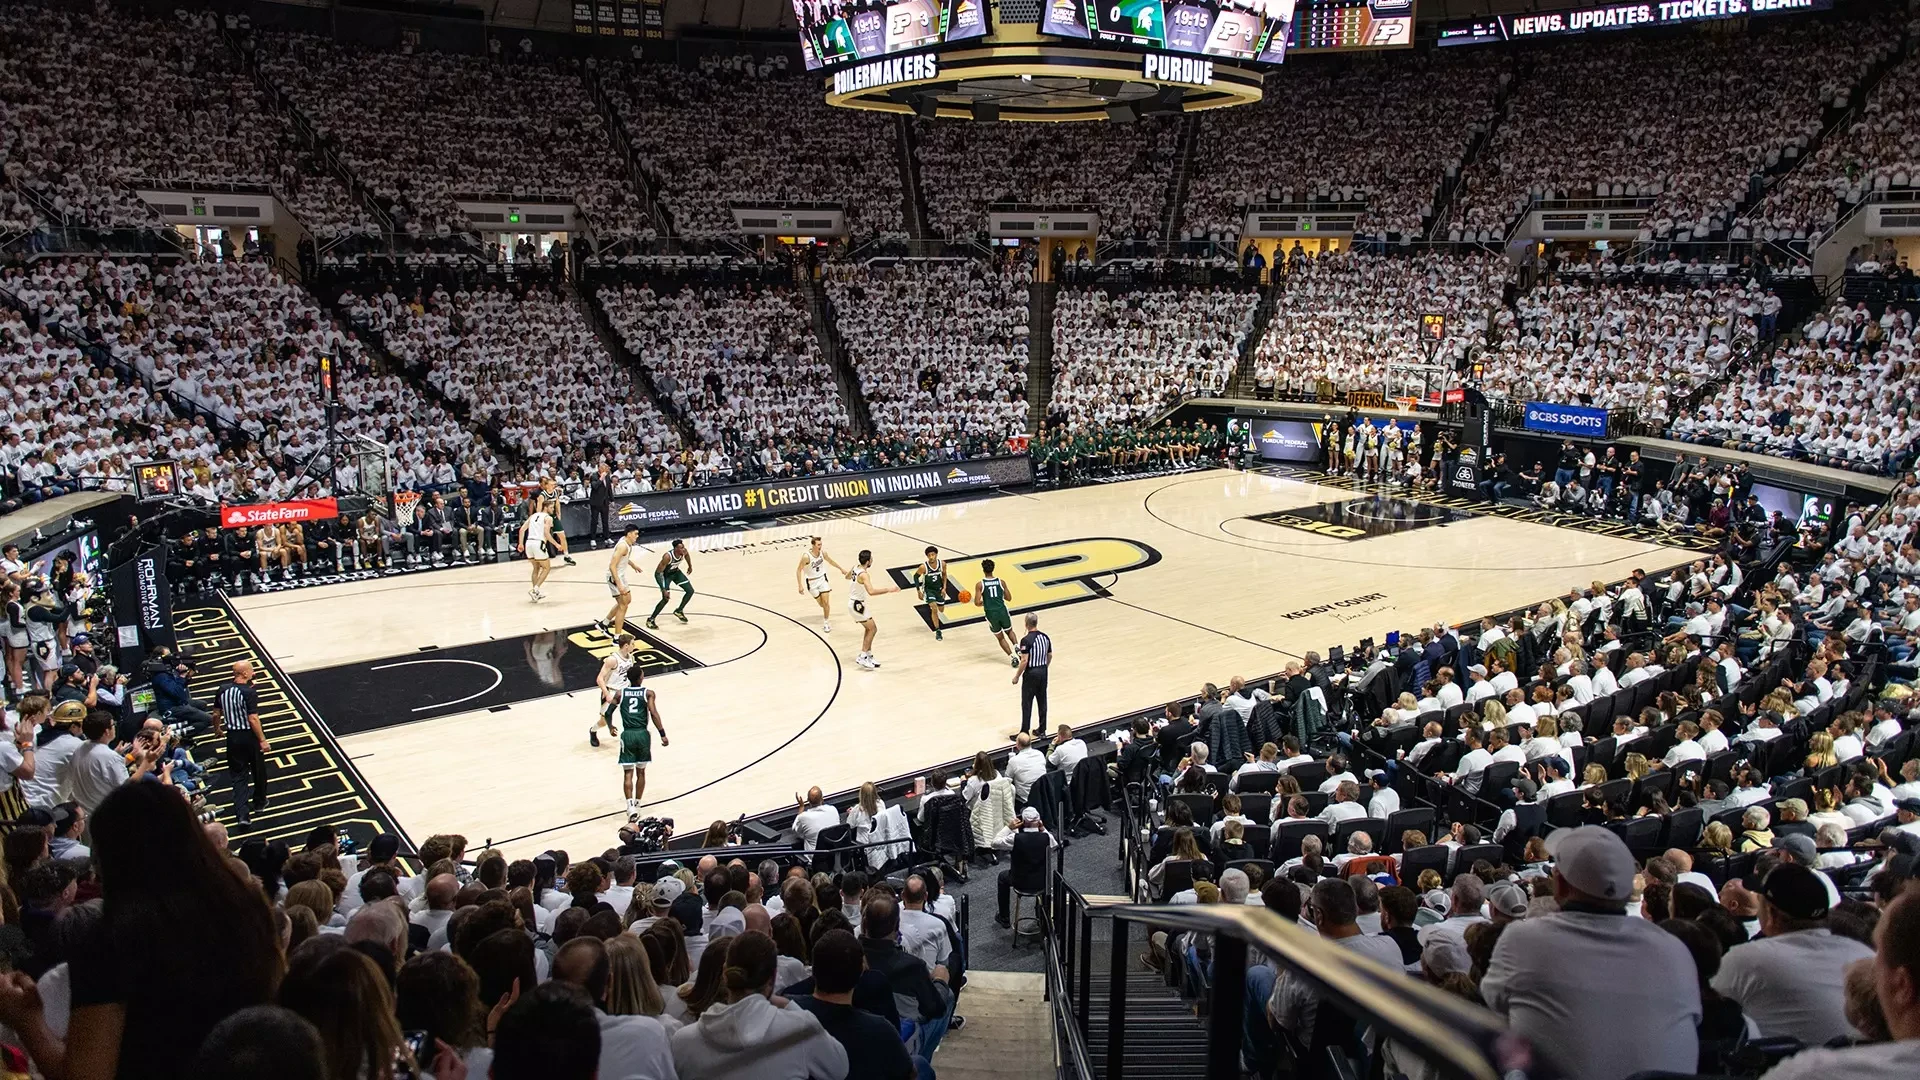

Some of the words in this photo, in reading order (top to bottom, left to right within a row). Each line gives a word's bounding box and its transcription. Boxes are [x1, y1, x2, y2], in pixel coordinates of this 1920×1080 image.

[920, 10, 929, 26] 3
[1110, 6, 1120, 22] 0
[1173, 9, 1208, 28] 19:15
[1513, 15, 1565, 35] NEWS.
[1570, 5, 1654, 30] UPDATES.
[1659, 0, 1747, 20] TICKETS.
[854, 15, 880, 33] 19:15
[893, 13, 911, 35] P
[1216, 22, 1239, 41] P
[1374, 24, 1403, 40] P
[823, 35, 830, 48] 0
[1244, 26, 1253, 42] 3
[834, 53, 936, 95] BOILERMAKERS
[1145, 53, 1213, 86] PURDUE
[1242, 422, 1250, 430] 0
[1538, 412, 1558, 424] CBS
[1560, 413, 1602, 428] SPORTS
[156, 478, 168, 492] 9
[948, 476, 968, 484] PURDUE
[969, 474, 990, 482] FEDERAL
[686, 493, 743, 516] NAMED
[744, 488, 767, 510] #1
[768, 485, 820, 506] CREDIT
[824, 479, 870, 500] UNION
[871, 477, 887, 494] IN
[888, 472, 942, 492] INDIANA
[247, 507, 309, 522] StateFarm
[618, 512, 647, 522] PURDUE
[648, 509, 679, 518] FEDERAL
[1824, 504, 1832, 515] 0
[92, 536, 98, 549] 0
[699, 543, 757, 554] KEADY
[138, 562, 148, 604] AUTOMOTIVE
[141, 558, 164, 629] ROHRMAN
[988, 586, 998, 598] 11
[1280, 604, 1336, 620] KEADY
[1334, 592, 1388, 608] COURT
[142, 604, 150, 630] GROUP
[628, 698, 638, 714] 2
